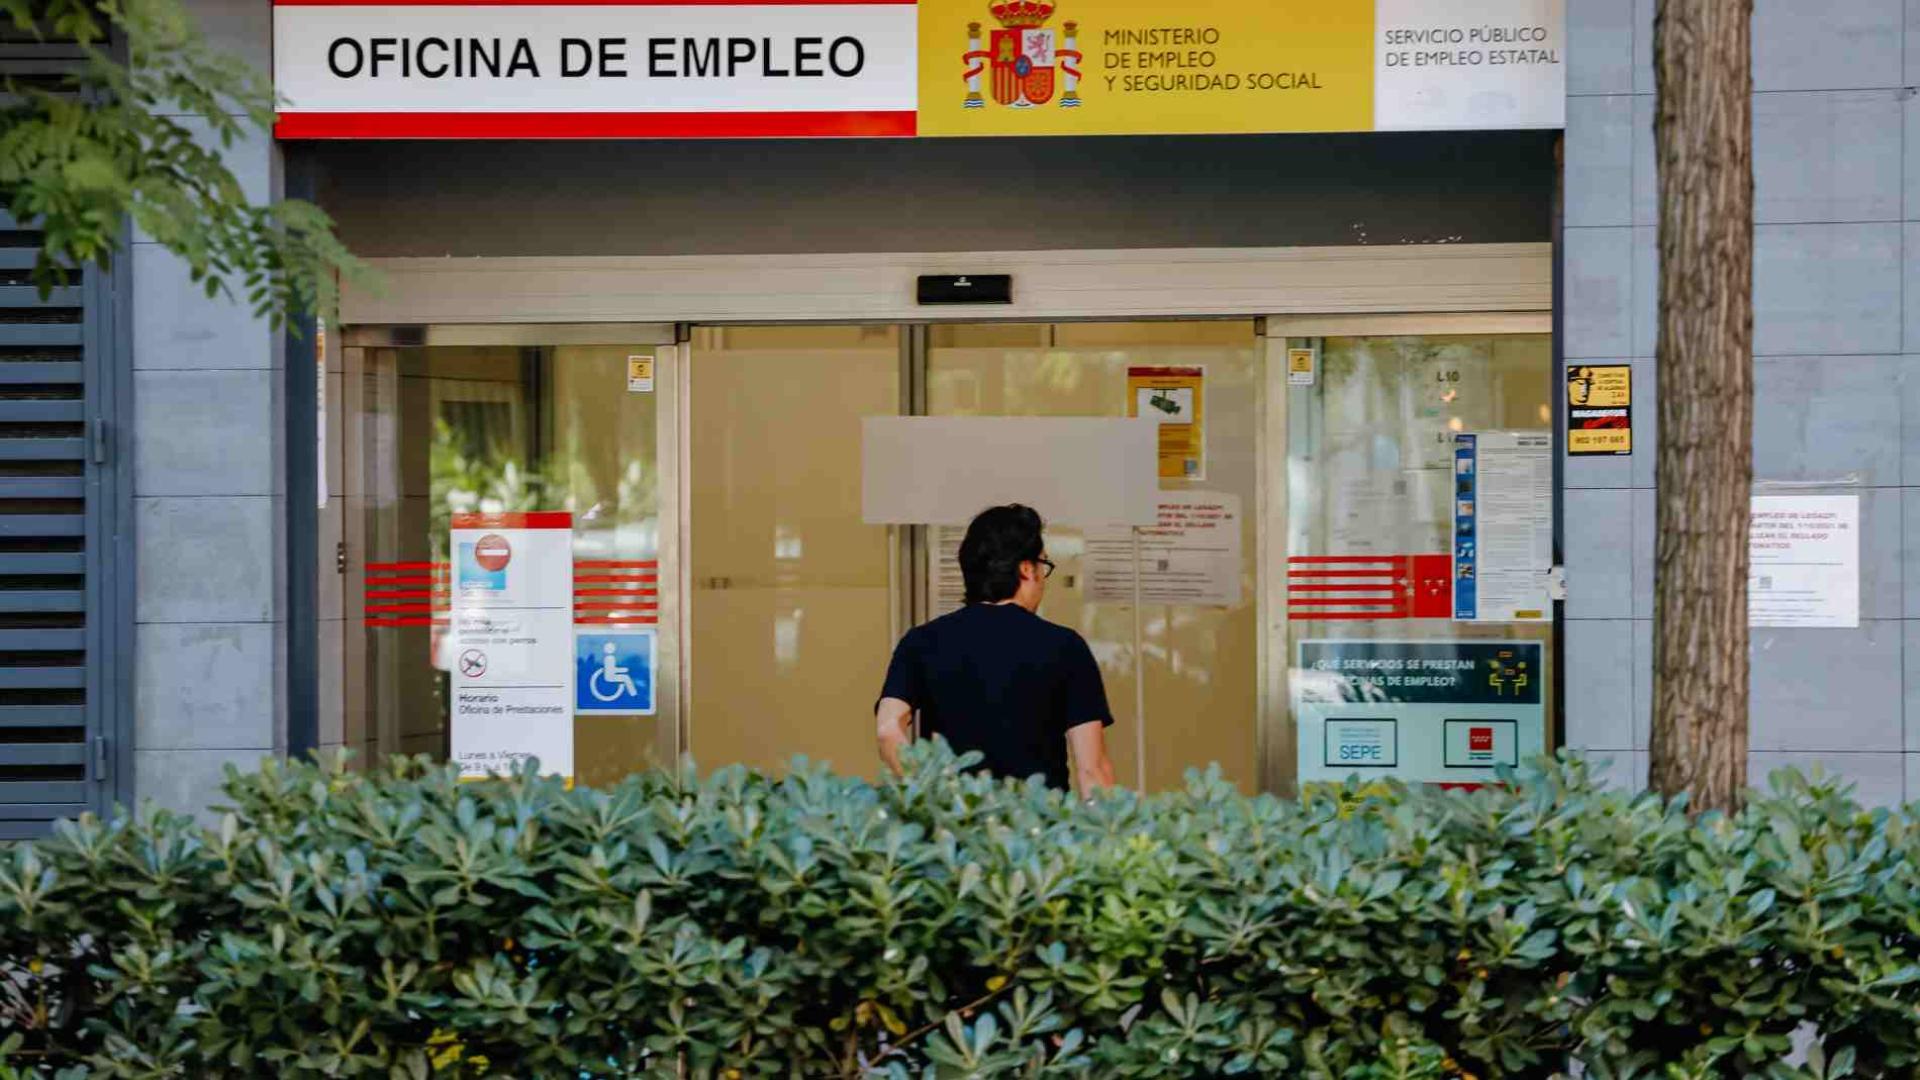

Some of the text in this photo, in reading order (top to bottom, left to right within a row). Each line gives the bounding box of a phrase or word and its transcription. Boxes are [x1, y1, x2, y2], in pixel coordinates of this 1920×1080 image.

[1104, 27, 1220, 46] MINISTERIO
[1385, 25, 1548, 45] SERVICIO PÚBLICO
[327, 35, 865, 79] OFICINA DE EMPLEO
[1104, 51, 1216, 69] DE EMPLEO
[1385, 49, 1560, 67] DE EMPLEO ESTATAL
[1104, 72, 1323, 92] Y SEGURIDAD SOCIAL
[1422, 659, 1476, 670] PRESTAN
[1387, 676, 1401, 687] DE
[1403, 676, 1457, 688] EMPLEO?
[1340, 745, 1382, 760] SEPE
